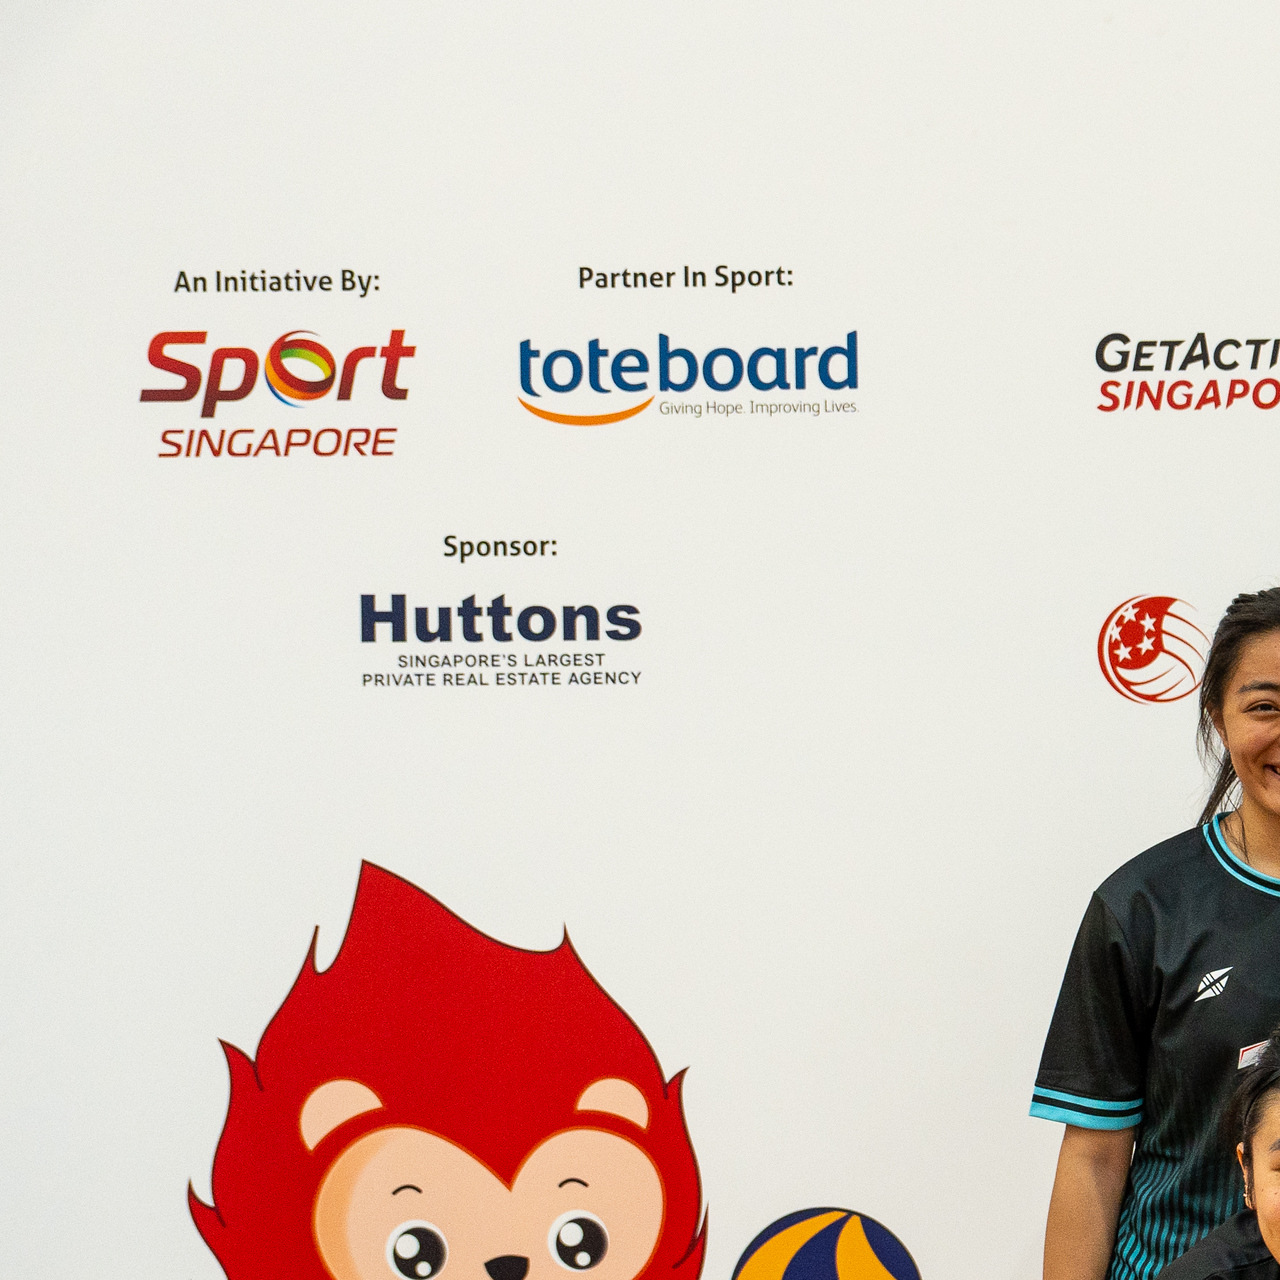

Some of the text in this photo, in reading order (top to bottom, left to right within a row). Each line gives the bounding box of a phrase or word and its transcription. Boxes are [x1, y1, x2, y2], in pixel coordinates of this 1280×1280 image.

[174, 269, 379, 298] An Initiative By:
[579, 265, 793, 293] Partner In Sport:
[140, 329, 416, 418] Sport
[659, 400, 856, 418] Giving Hope. Improving Lives.
[158, 428, 398, 458] SINGAPORE
[444, 535, 557, 564] Sponsor:
[360, 594, 642, 643] Huttons
[398, 653, 605, 668] SINGAPORE'S LARGEST
[363, 672, 641, 686] PRIVATE REAL ESTATE AGENCY
